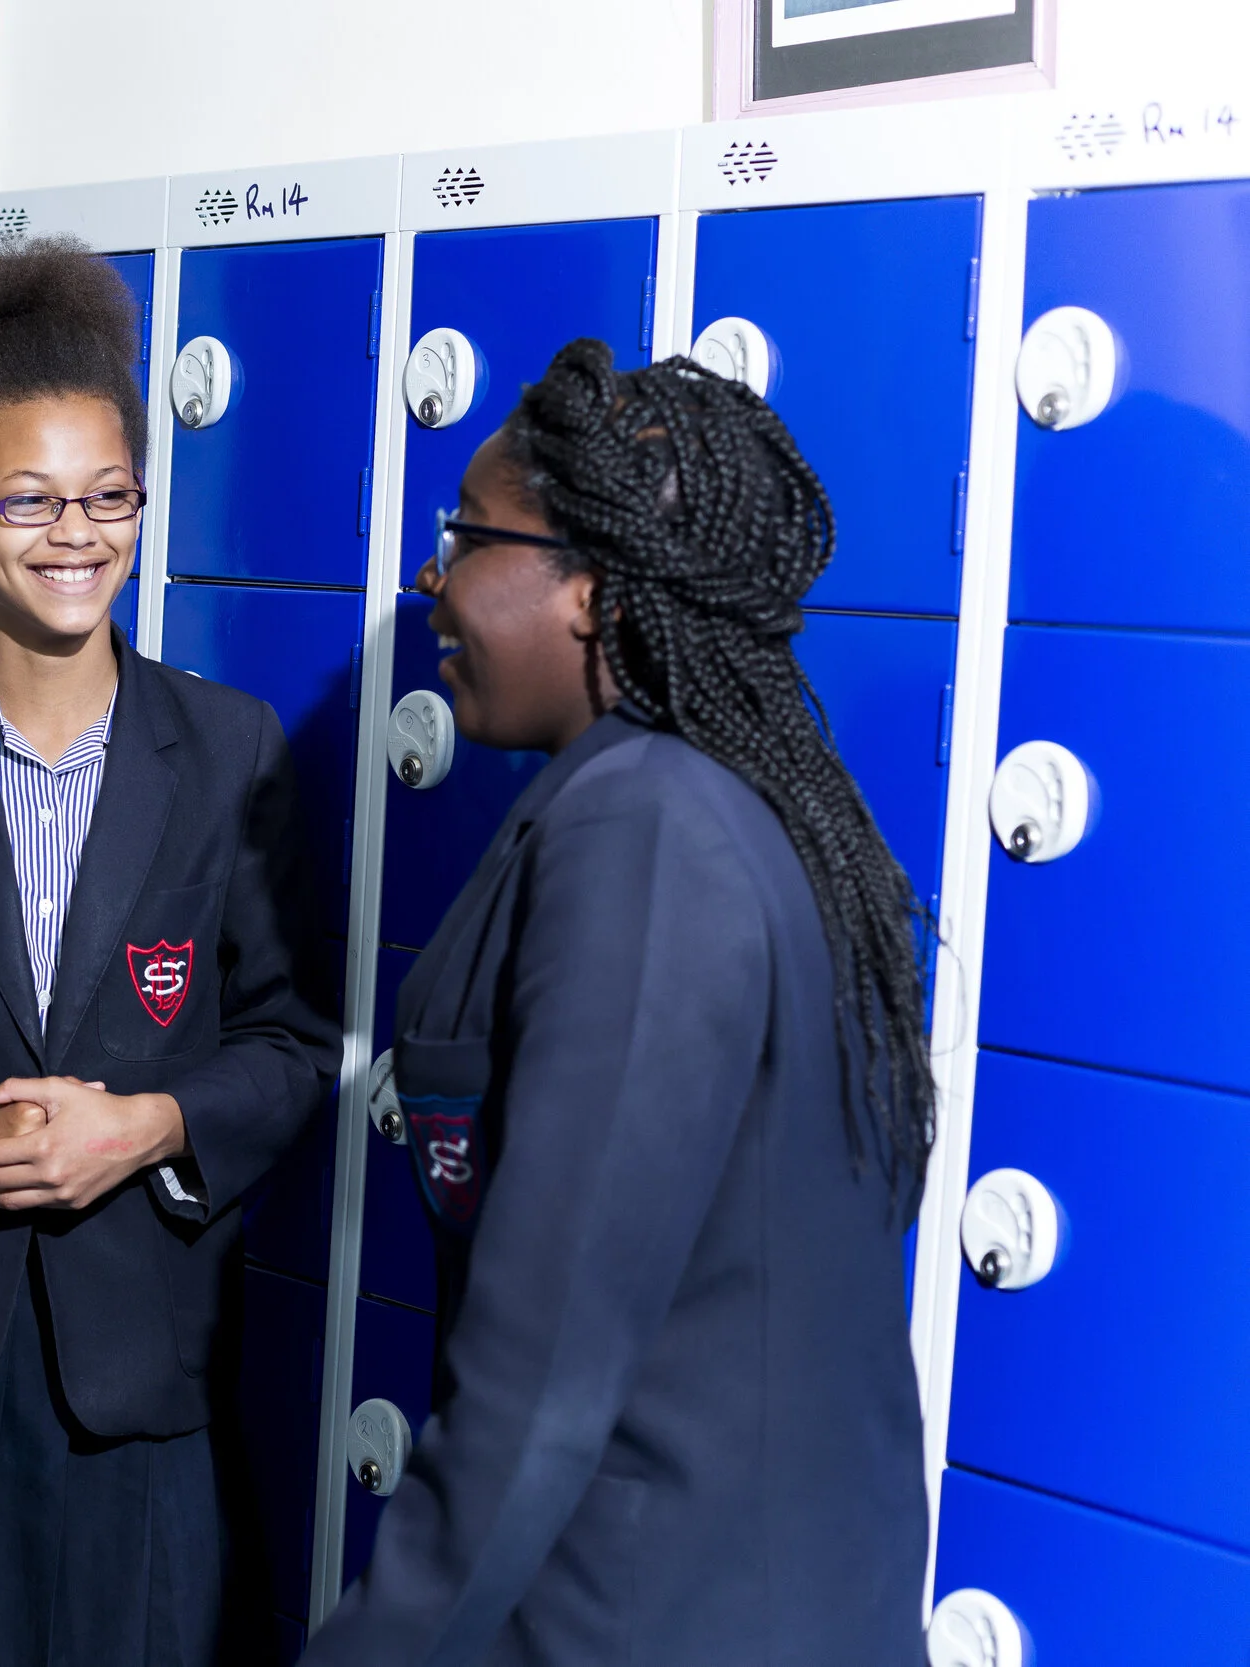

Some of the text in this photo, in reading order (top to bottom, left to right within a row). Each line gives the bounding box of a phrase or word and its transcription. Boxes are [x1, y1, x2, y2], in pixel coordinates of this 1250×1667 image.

[1204, 104, 1241, 137] 14
[282, 182, 309, 217] 14
[185, 360, 192, 374] 2
[423, 354, 431, 368] 3
[406, 715, 414, 729] 9
